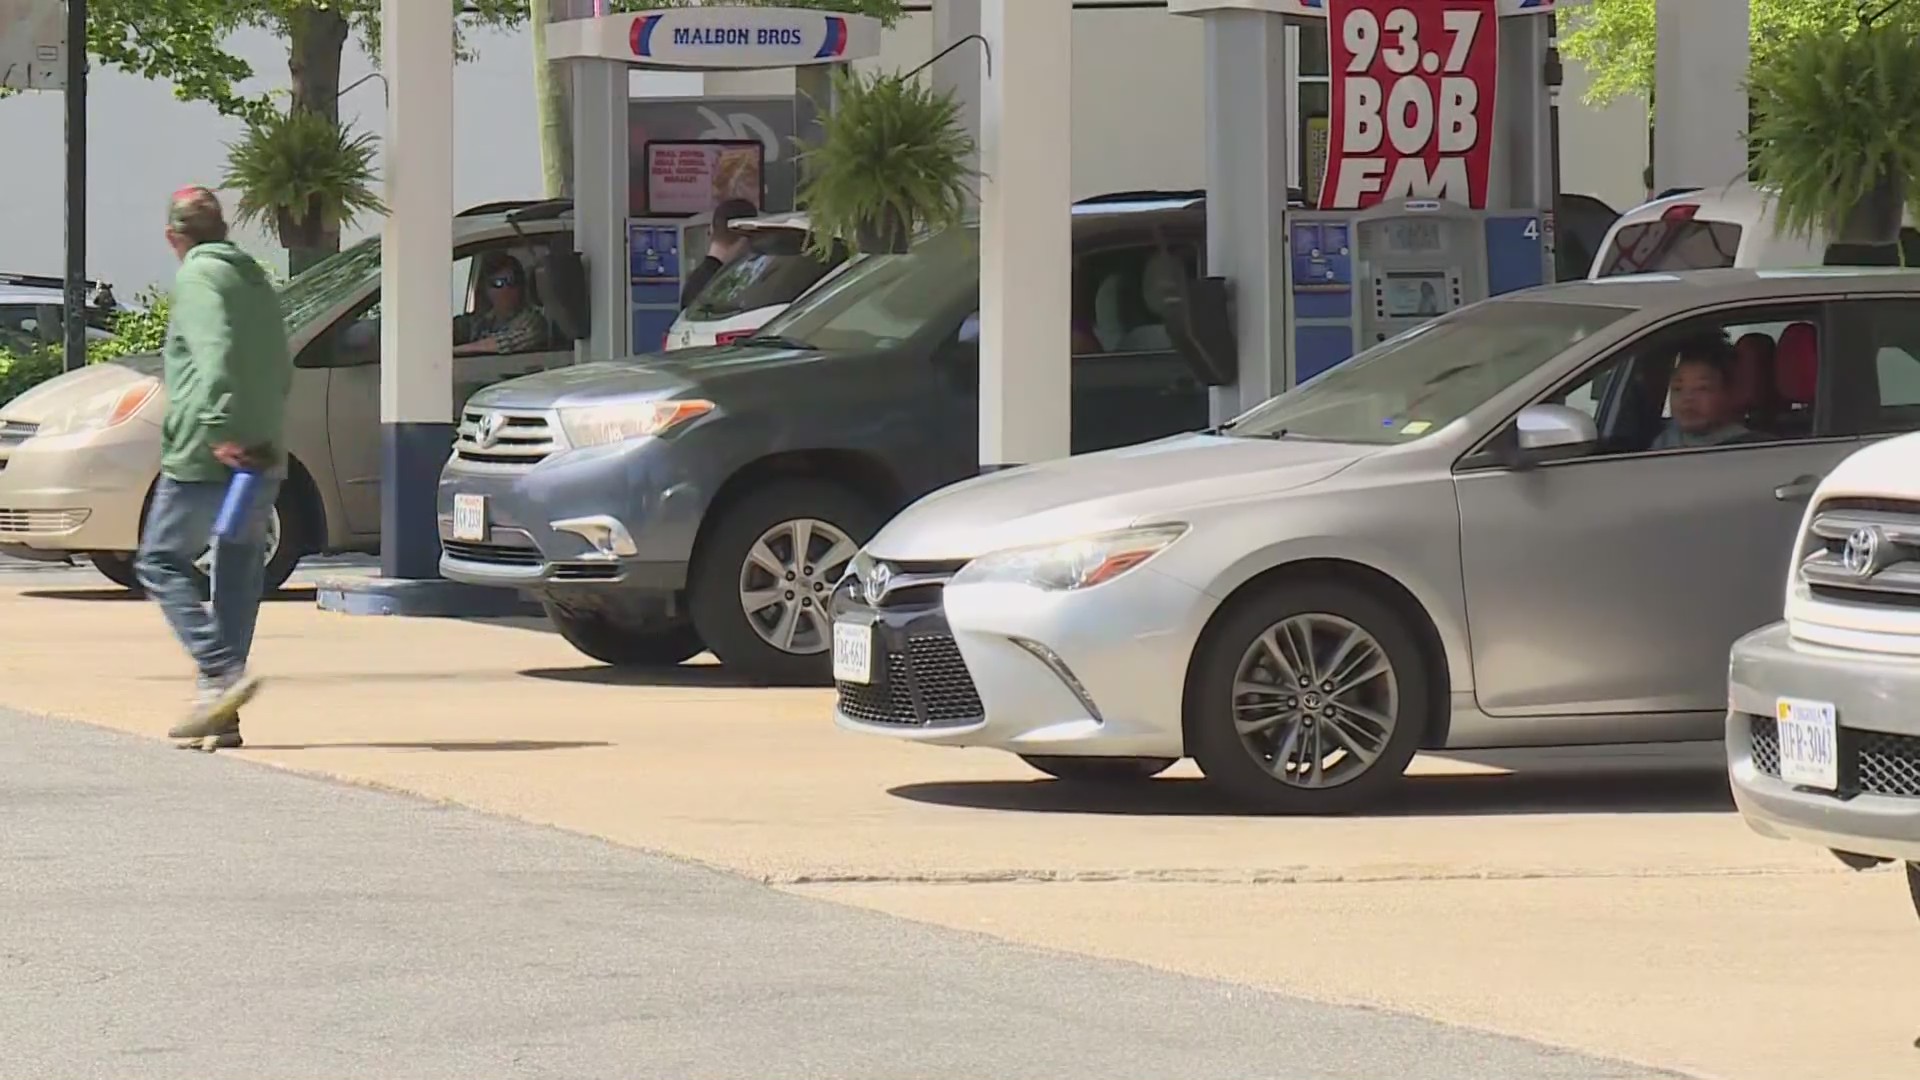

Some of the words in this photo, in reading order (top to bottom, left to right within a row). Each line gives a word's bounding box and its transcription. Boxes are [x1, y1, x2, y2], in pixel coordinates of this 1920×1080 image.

[674, 28, 749, 45] MALBON
[757, 28, 801, 45] BROS
[1343, 8, 1482, 74] 93.7
[1342, 74, 1478, 154] BOB
[1333, 157, 1471, 208] FM
[1523, 219, 1539, 241] 4
[1781, 721, 1832, 765] UFR-3043
